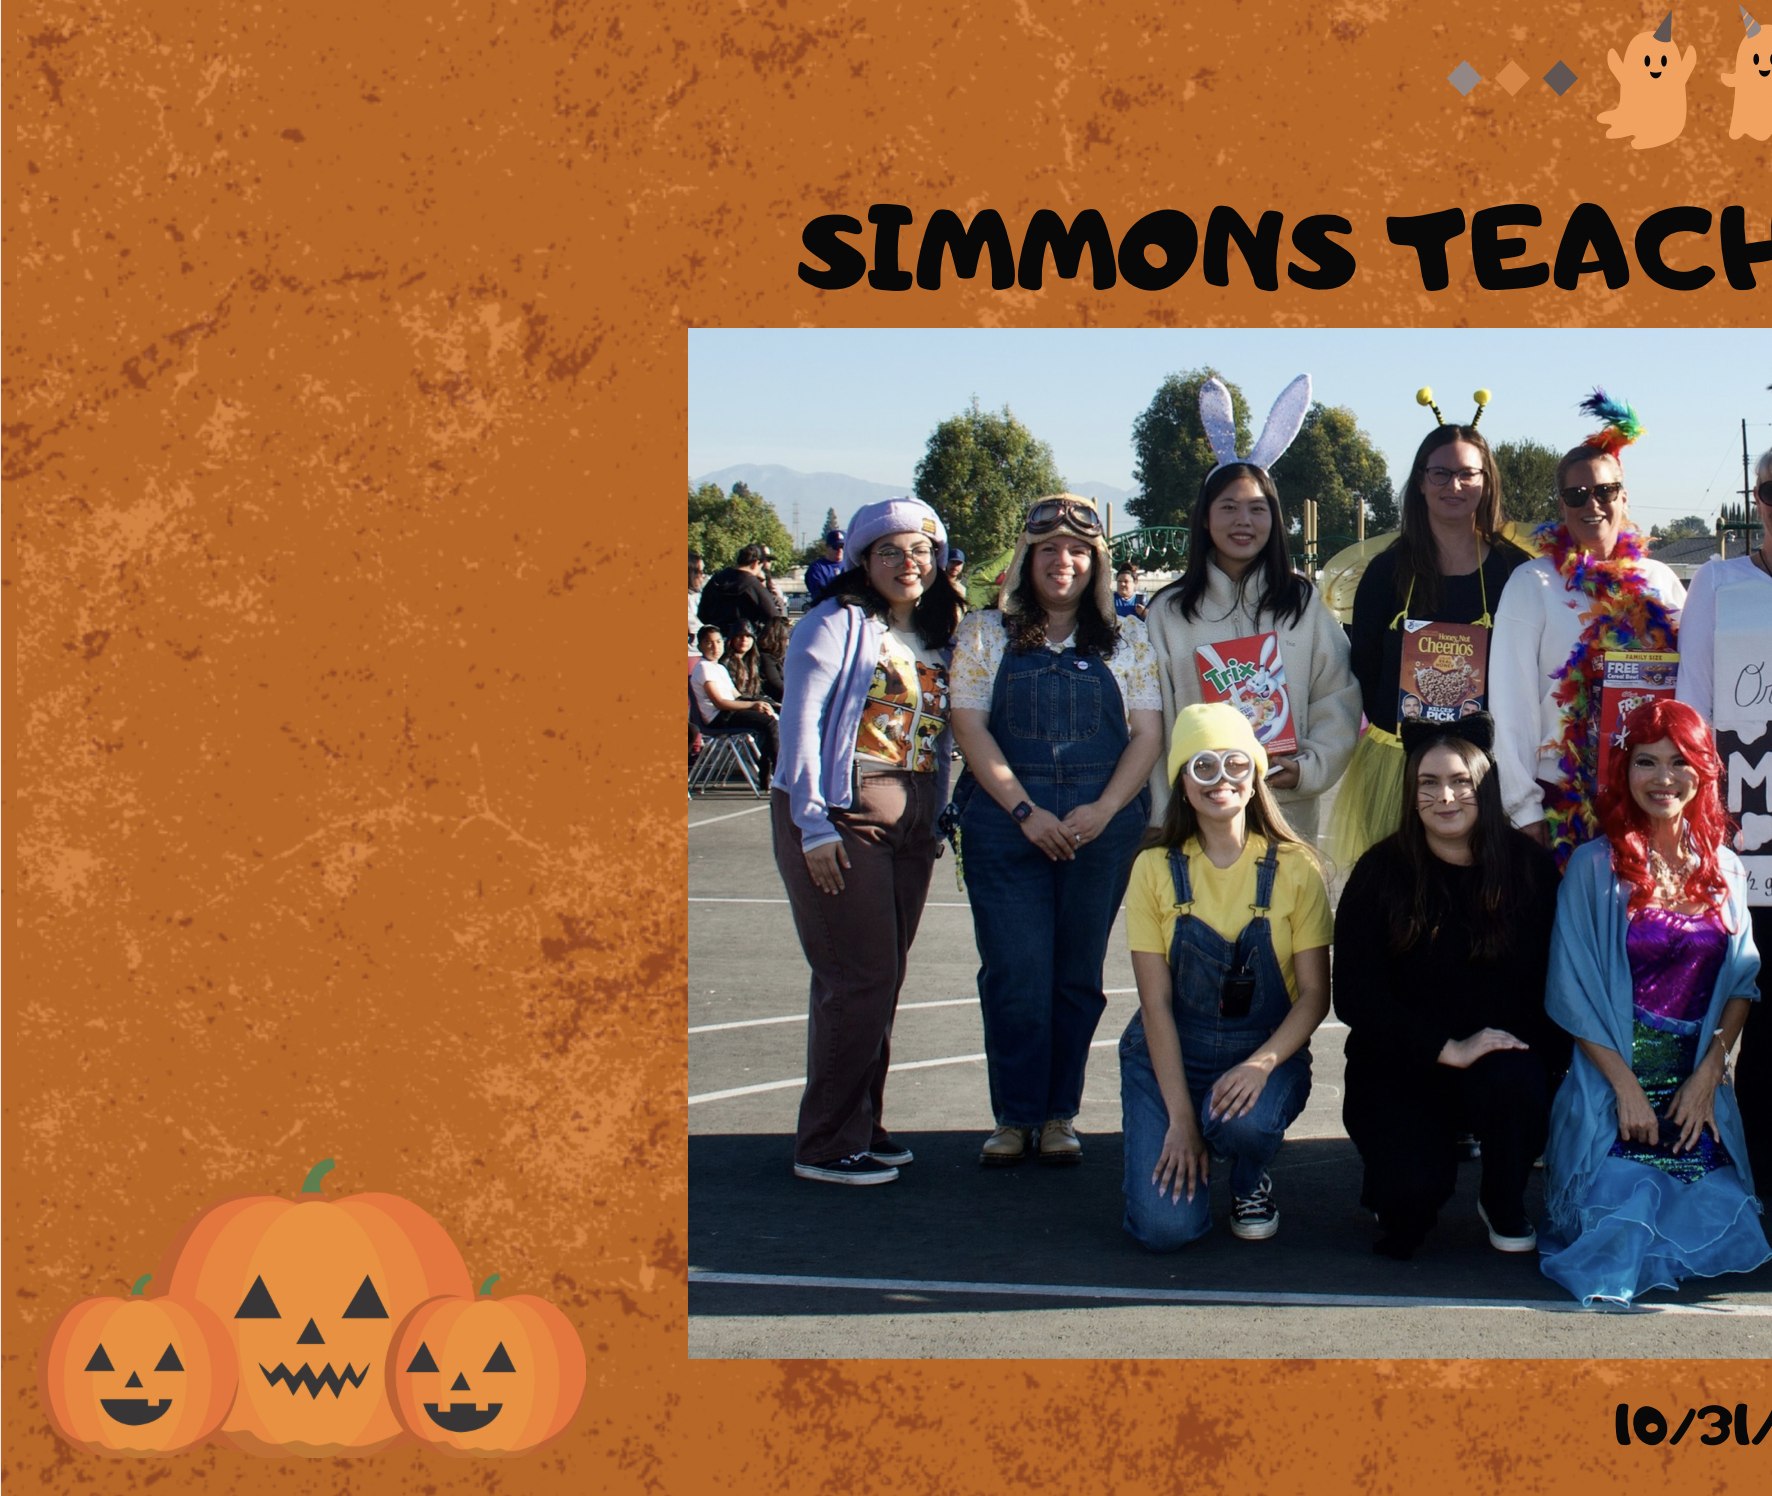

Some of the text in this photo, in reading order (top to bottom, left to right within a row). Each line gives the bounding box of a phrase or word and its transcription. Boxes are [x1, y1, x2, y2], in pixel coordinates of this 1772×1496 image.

[1439, 633, 1458, 643] Honey
[1418, 637, 1474, 656] Cheerios
[1607, 662, 1639, 674] FREE
[1203, 658, 1257, 693] Trix
[1427, 712, 1455, 721] PICK
